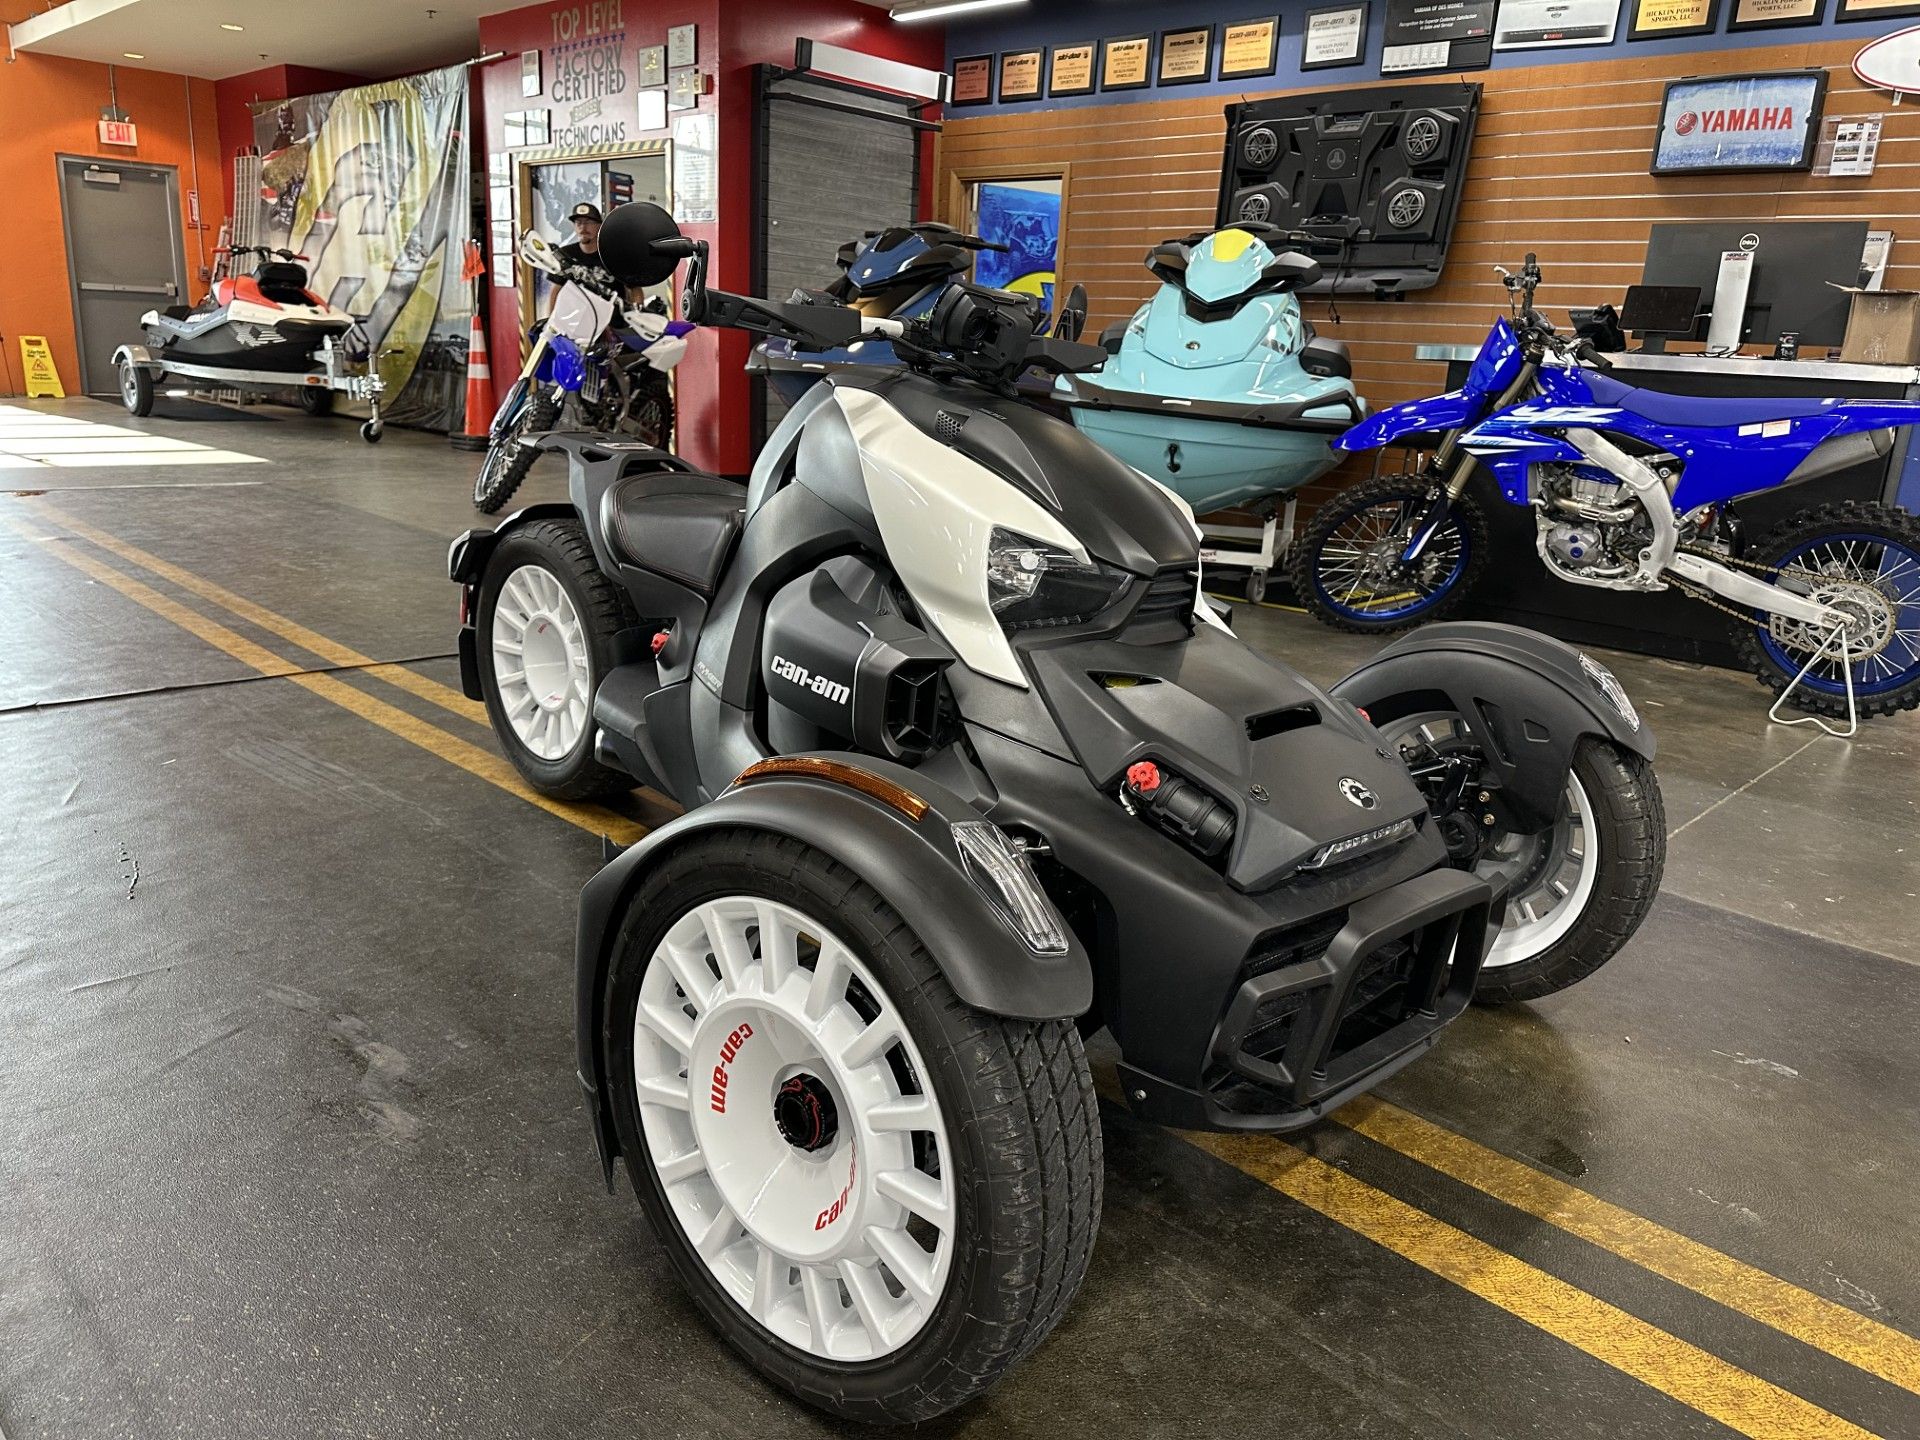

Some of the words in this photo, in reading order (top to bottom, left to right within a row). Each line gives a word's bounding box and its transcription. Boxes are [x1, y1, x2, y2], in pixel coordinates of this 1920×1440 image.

[551, 7, 580, 42] TOP
[585, 0, 625, 35] LEVEL
[1646, 9, 1674, 17] HICKLIN
[1676, 6, 1701, 14] POWER
[555, 43, 623, 79] FACTORY
[552, 69, 626, 103] CERTIFIED
[107, 123, 131, 143] EXIT
[553, 121, 625, 149] TECHNICIANS
[1701, 106, 1793, 133] YAMAHA
[770, 655, 851, 706] can-am
[711, 1022, 754, 1114] can-am
